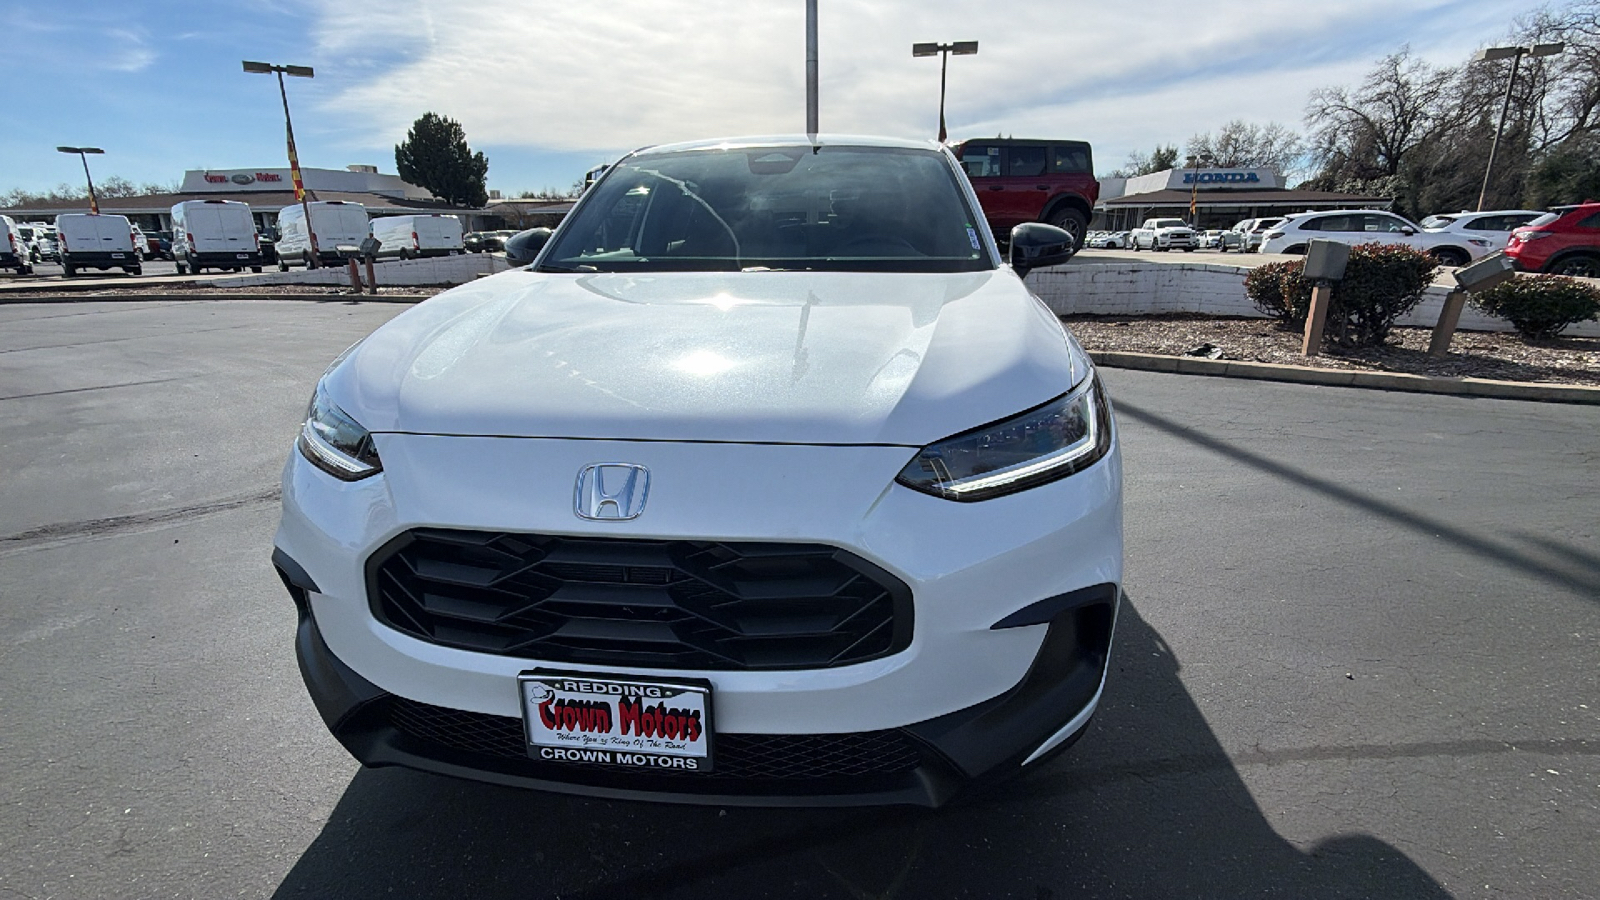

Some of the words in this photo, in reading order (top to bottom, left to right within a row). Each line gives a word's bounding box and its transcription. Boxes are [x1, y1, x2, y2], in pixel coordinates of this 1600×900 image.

[1183, 172, 1260, 183] HONDA
[564, 681, 661, 697] REDDING
[538, 696, 612, 733] Crown
[618, 697, 702, 742] Motors
[556, 732, 580, 741] Where
[610, 736, 631, 747] King
[633, 738, 644, 748] Of
[646, 739, 661, 747] The
[664, 741, 686, 750] Road
[540, 747, 611, 763] CROWN
[616, 754, 698, 769] MOTORS
